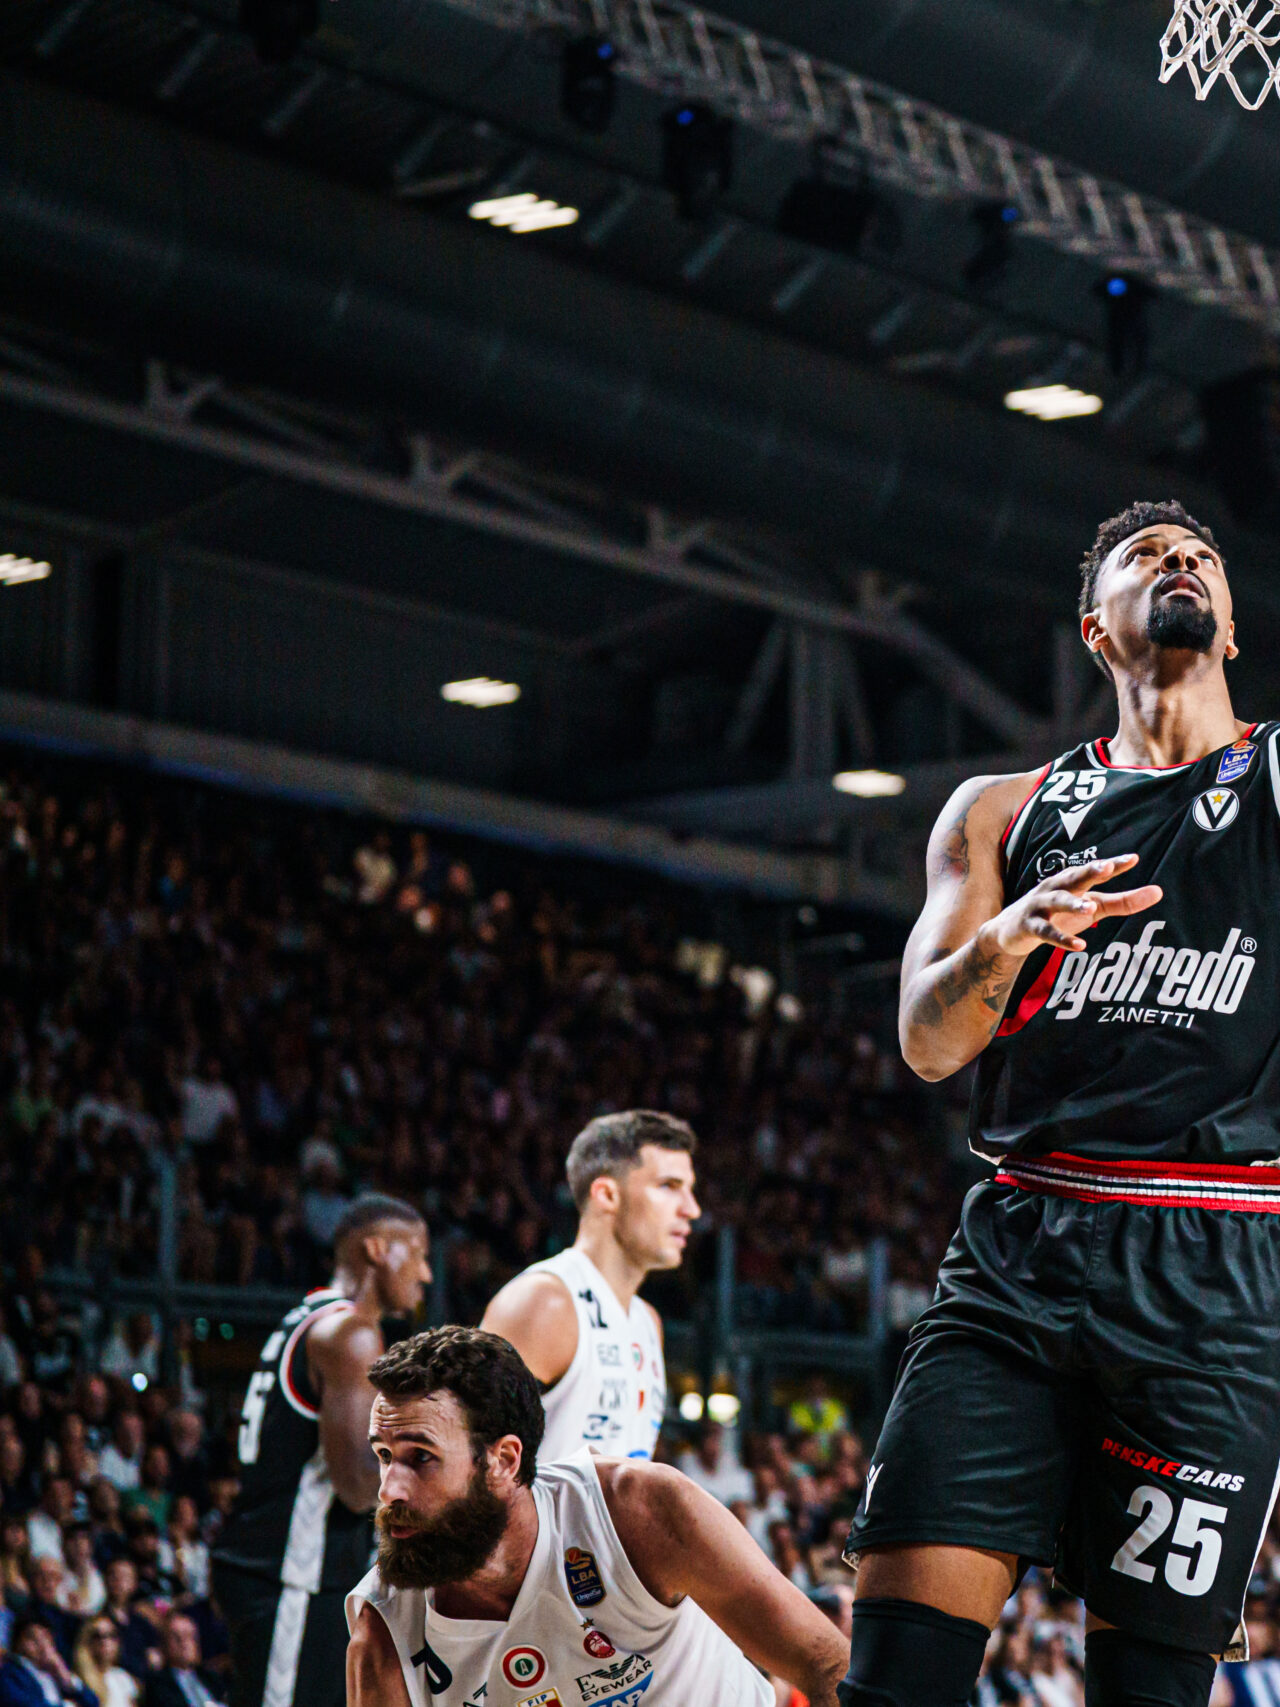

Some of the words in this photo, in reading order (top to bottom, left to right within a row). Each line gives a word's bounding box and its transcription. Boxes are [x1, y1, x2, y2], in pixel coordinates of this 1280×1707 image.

[1224, 753, 1249, 765] LBA
[1041, 769, 1107, 802] 25
[1046, 920, 1256, 1020] egafredo
[1097, 1005, 1196, 1029] ZANETTI
[1110, 1484, 1229, 1597] 25
[571, 1569, 597, 1585] LBA
[519, 1659, 530, 1675] A
[581, 1659, 653, 1702] EYEWEAR
